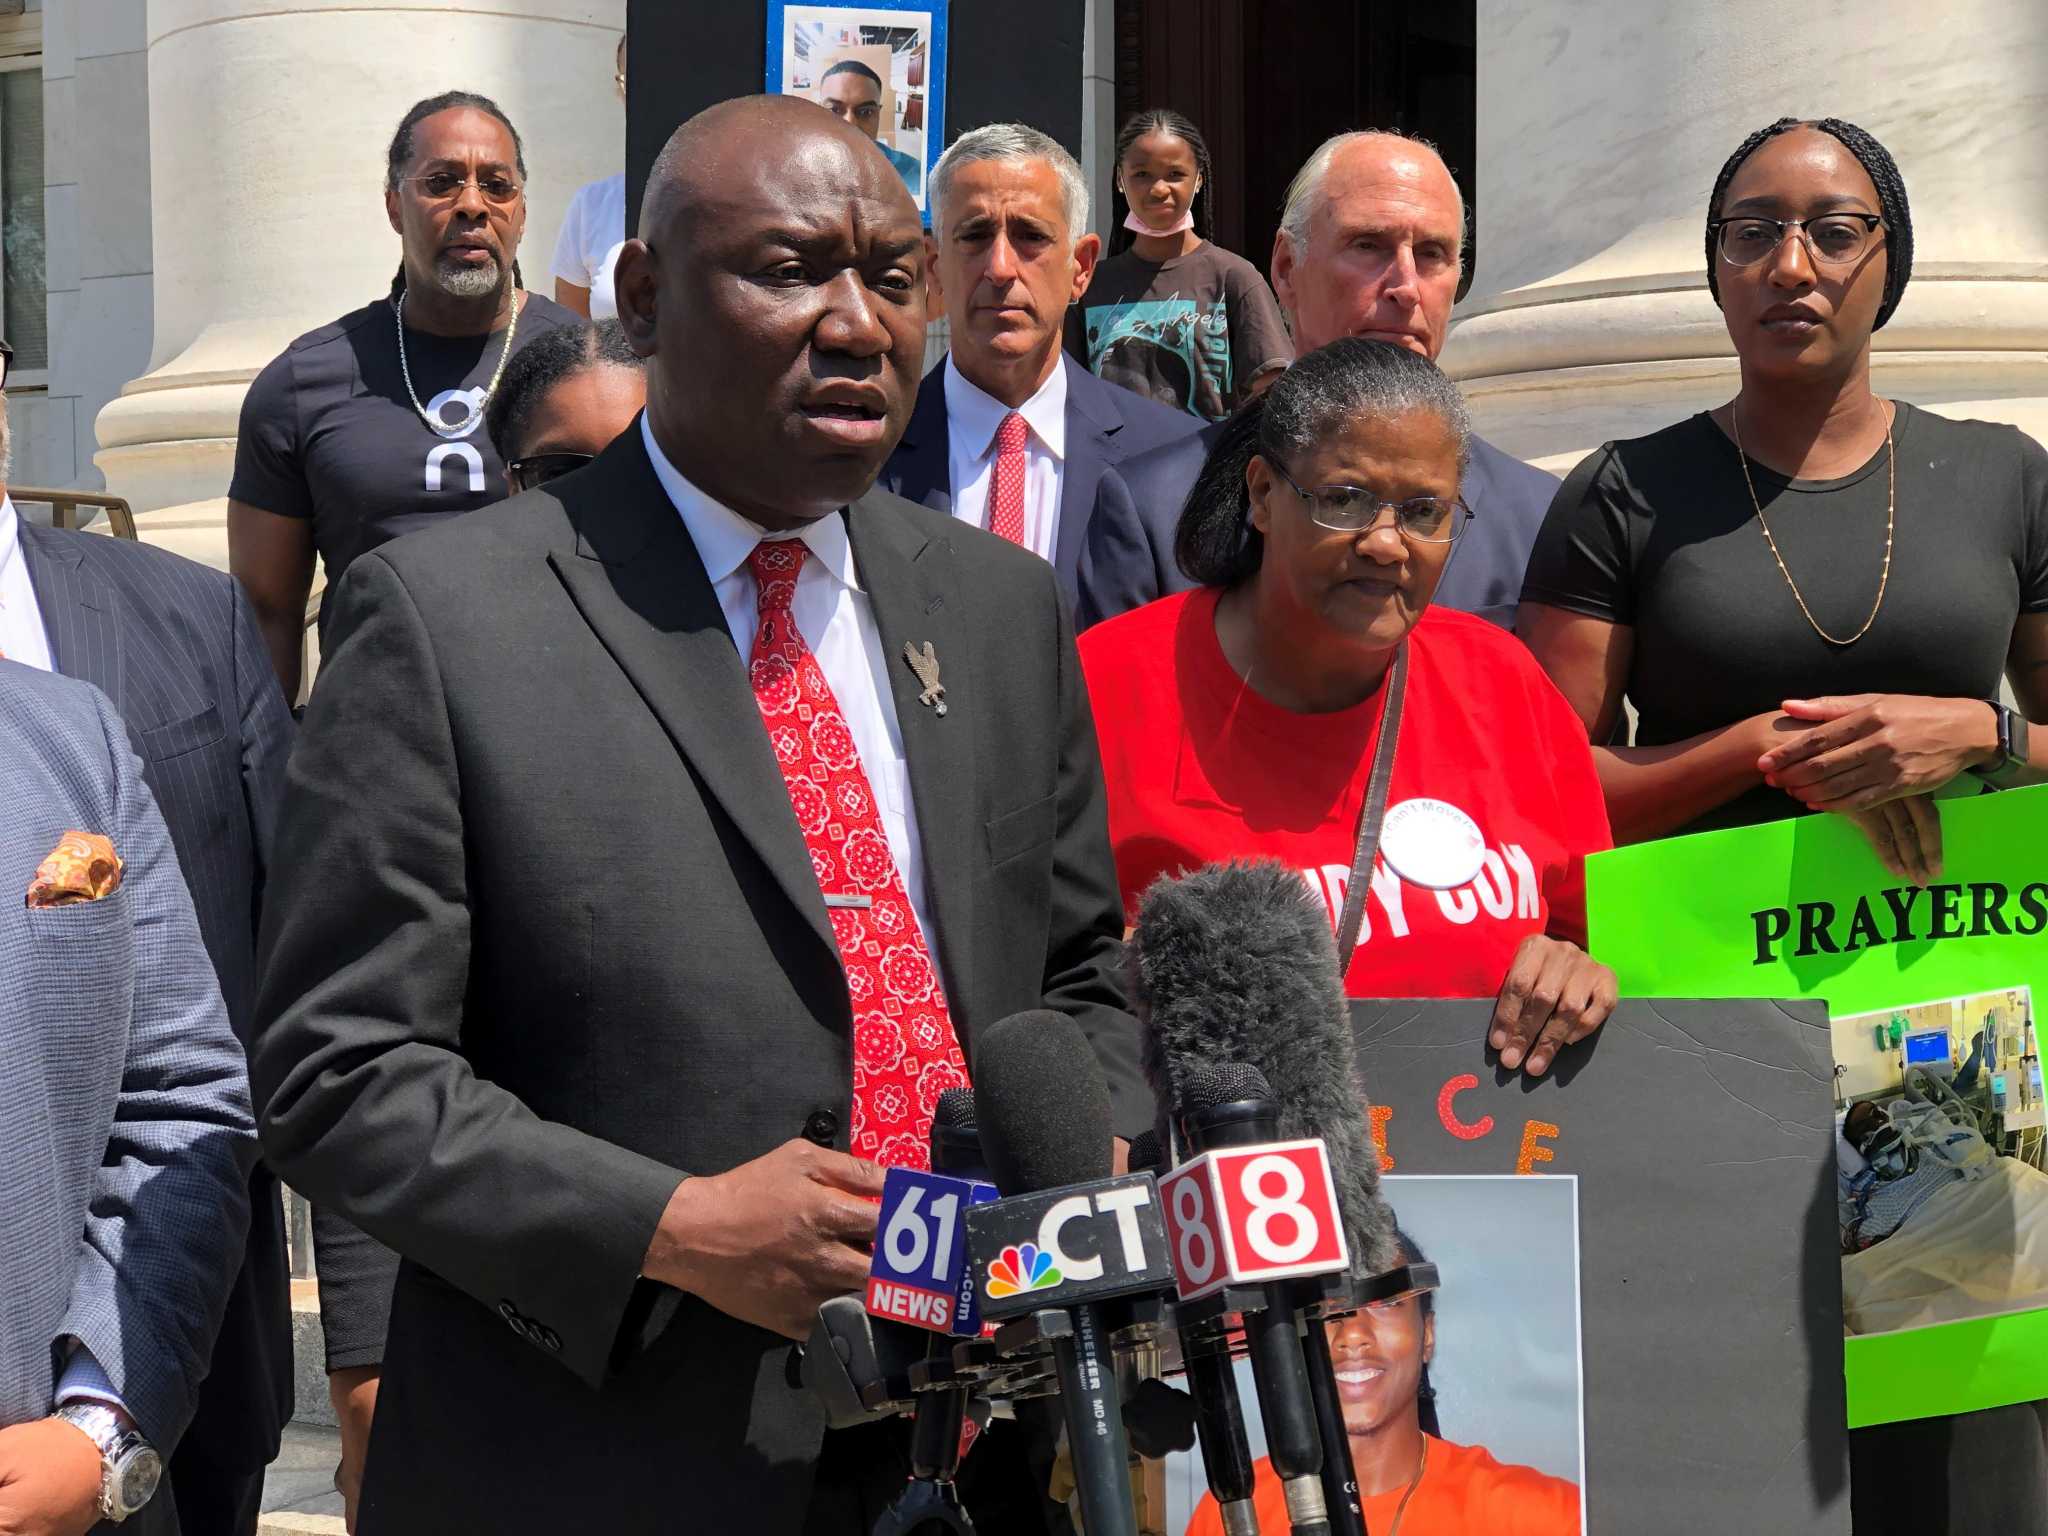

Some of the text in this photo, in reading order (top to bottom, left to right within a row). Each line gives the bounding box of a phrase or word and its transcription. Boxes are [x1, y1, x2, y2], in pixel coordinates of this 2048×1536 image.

[1751, 882, 2048, 965] PRAYERS
[884, 1186, 959, 1282] 61
[1037, 1185, 1152, 1282] CT
[1172, 1176, 1215, 1286] 8
[1240, 1155, 1319, 1263] 8
[872, 1283, 948, 1326] NEWS
[957, 1265, 974, 1321] .com
